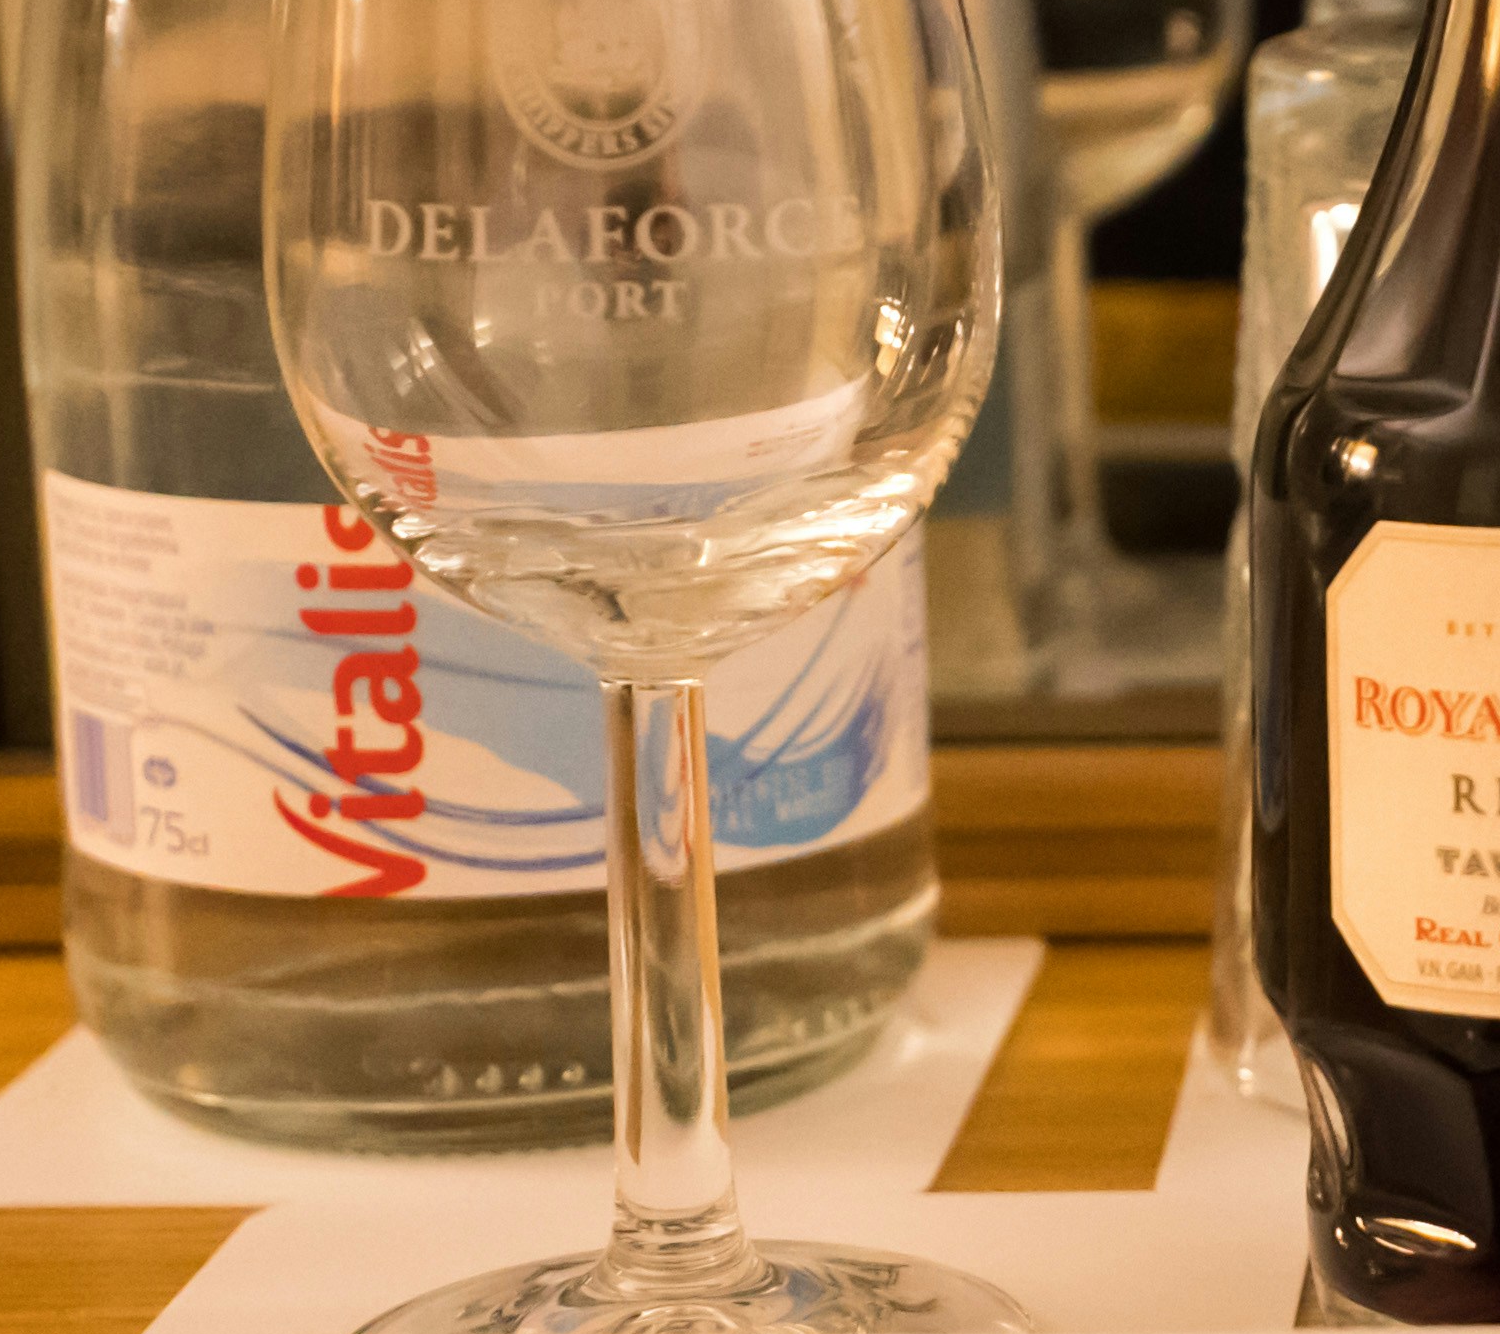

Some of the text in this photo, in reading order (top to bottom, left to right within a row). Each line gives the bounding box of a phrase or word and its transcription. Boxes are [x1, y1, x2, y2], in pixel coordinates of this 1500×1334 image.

[366, 195, 865, 264] DELAFORCE
[535, 279, 687, 323] PORT
[1414, 916, 1492, 948] REAL
